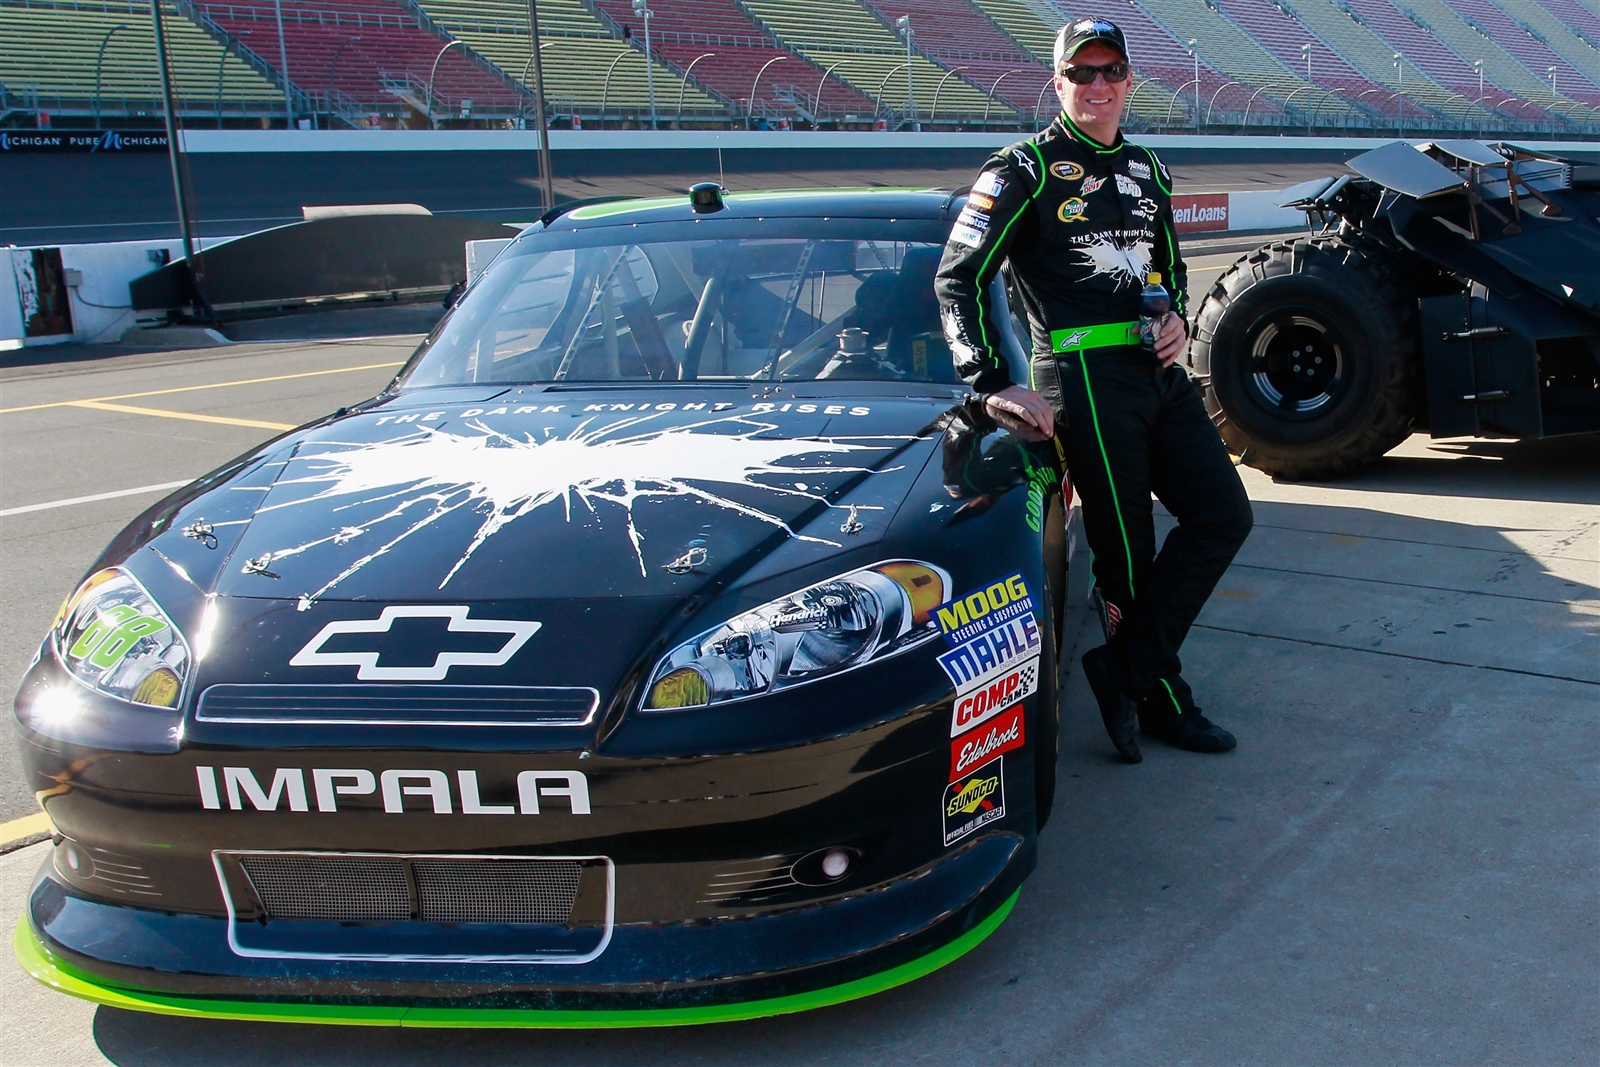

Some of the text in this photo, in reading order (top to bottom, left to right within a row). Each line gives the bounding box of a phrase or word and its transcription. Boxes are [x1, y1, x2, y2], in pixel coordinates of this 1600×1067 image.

[70, 130, 167, 152] PURE MICHIGAN
[1070, 235, 1091, 243] THE
[1093, 230, 1113, 240] DARK
[375, 402, 871, 427] THE DARK KNIGHT RISES
[768, 606, 828, 628] Hendrick
[937, 573, 1028, 635] MOOG
[951, 619, 987, 644] STEERING
[993, 597, 1034, 624] SUSPENSION
[68, 604, 169, 669] 88
[938, 614, 1041, 687] MAHLE
[956, 672, 1019, 727] COMP
[1000, 684, 1029, 708] CAMS
[955, 716, 1019, 772] Edelbrock
[196, 766, 592, 815] IMPALA
[949, 777, 996, 815] SUNOCO
